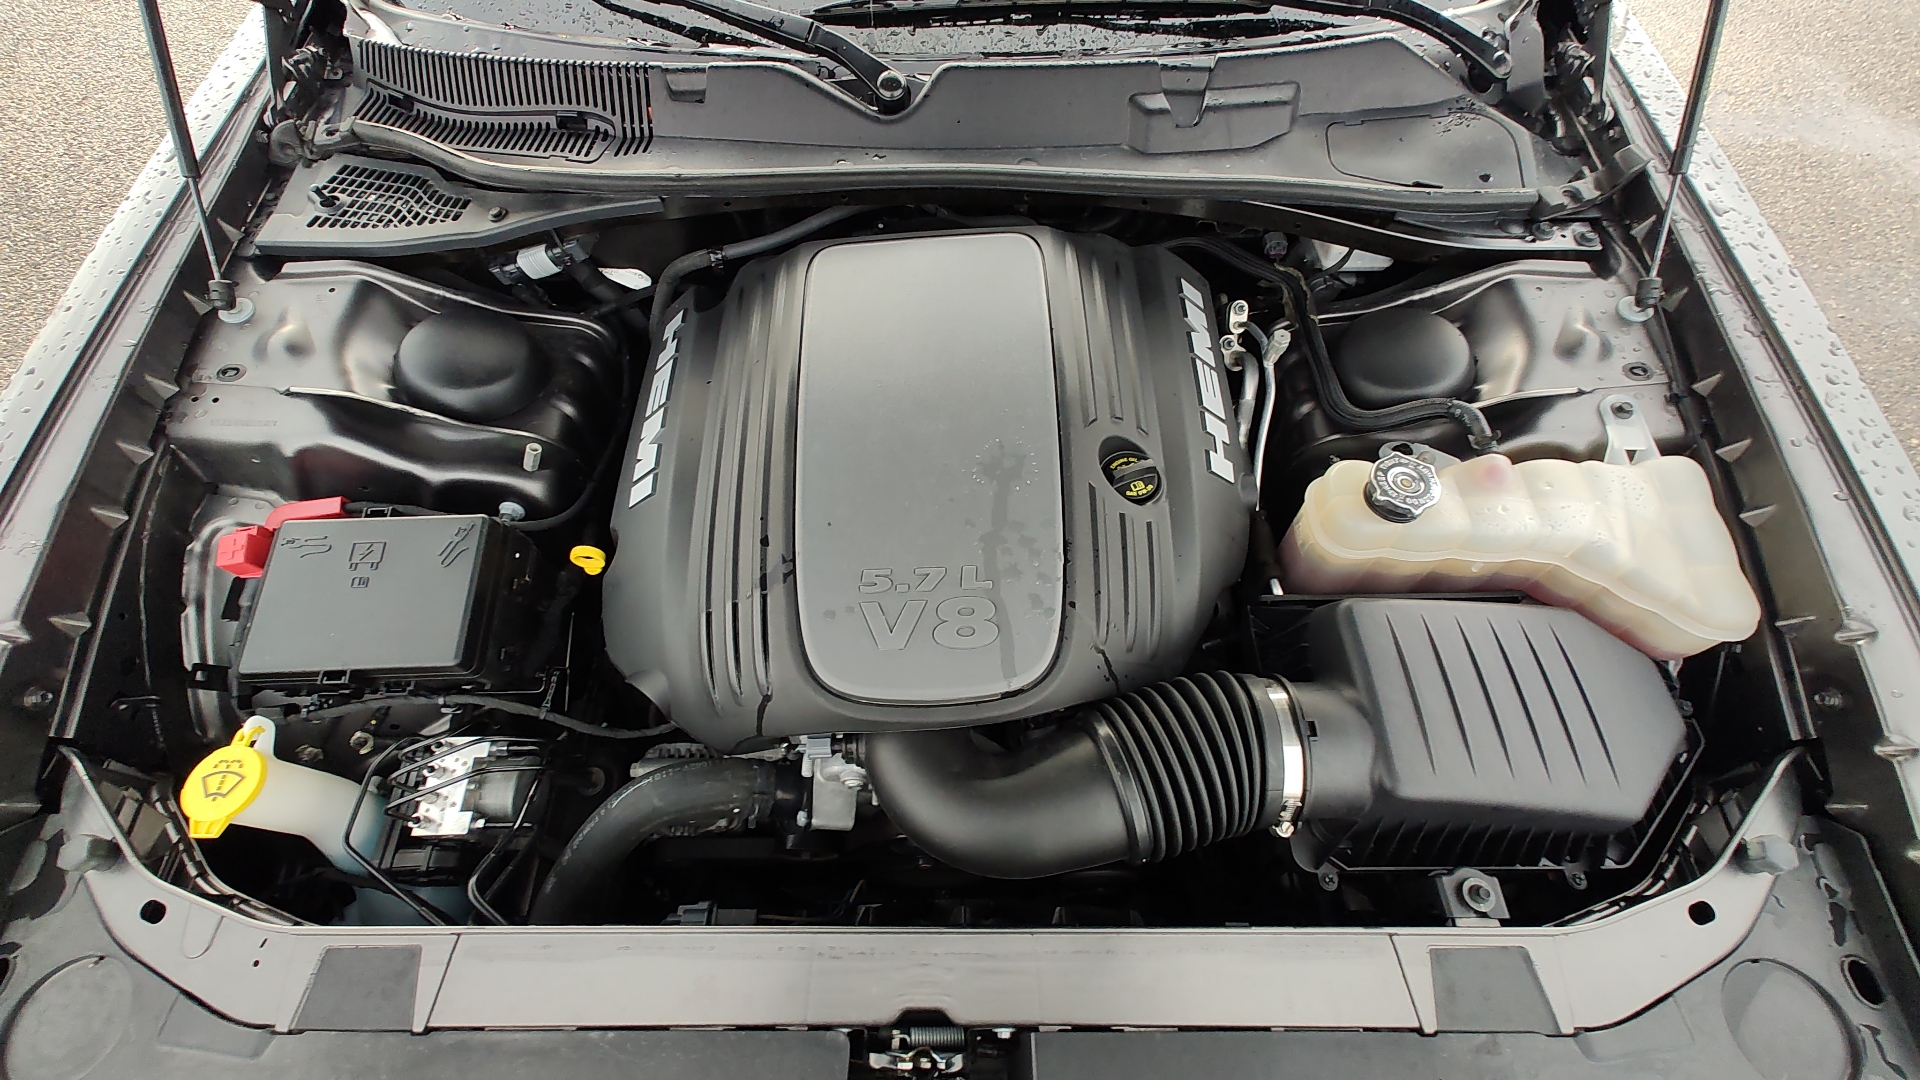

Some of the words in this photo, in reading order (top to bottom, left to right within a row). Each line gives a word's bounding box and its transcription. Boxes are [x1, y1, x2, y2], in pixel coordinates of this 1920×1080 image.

[629, 309, 687, 509] HEMI
[1181, 278, 1235, 484] HEMI
[858, 596, 999, 650] V8
